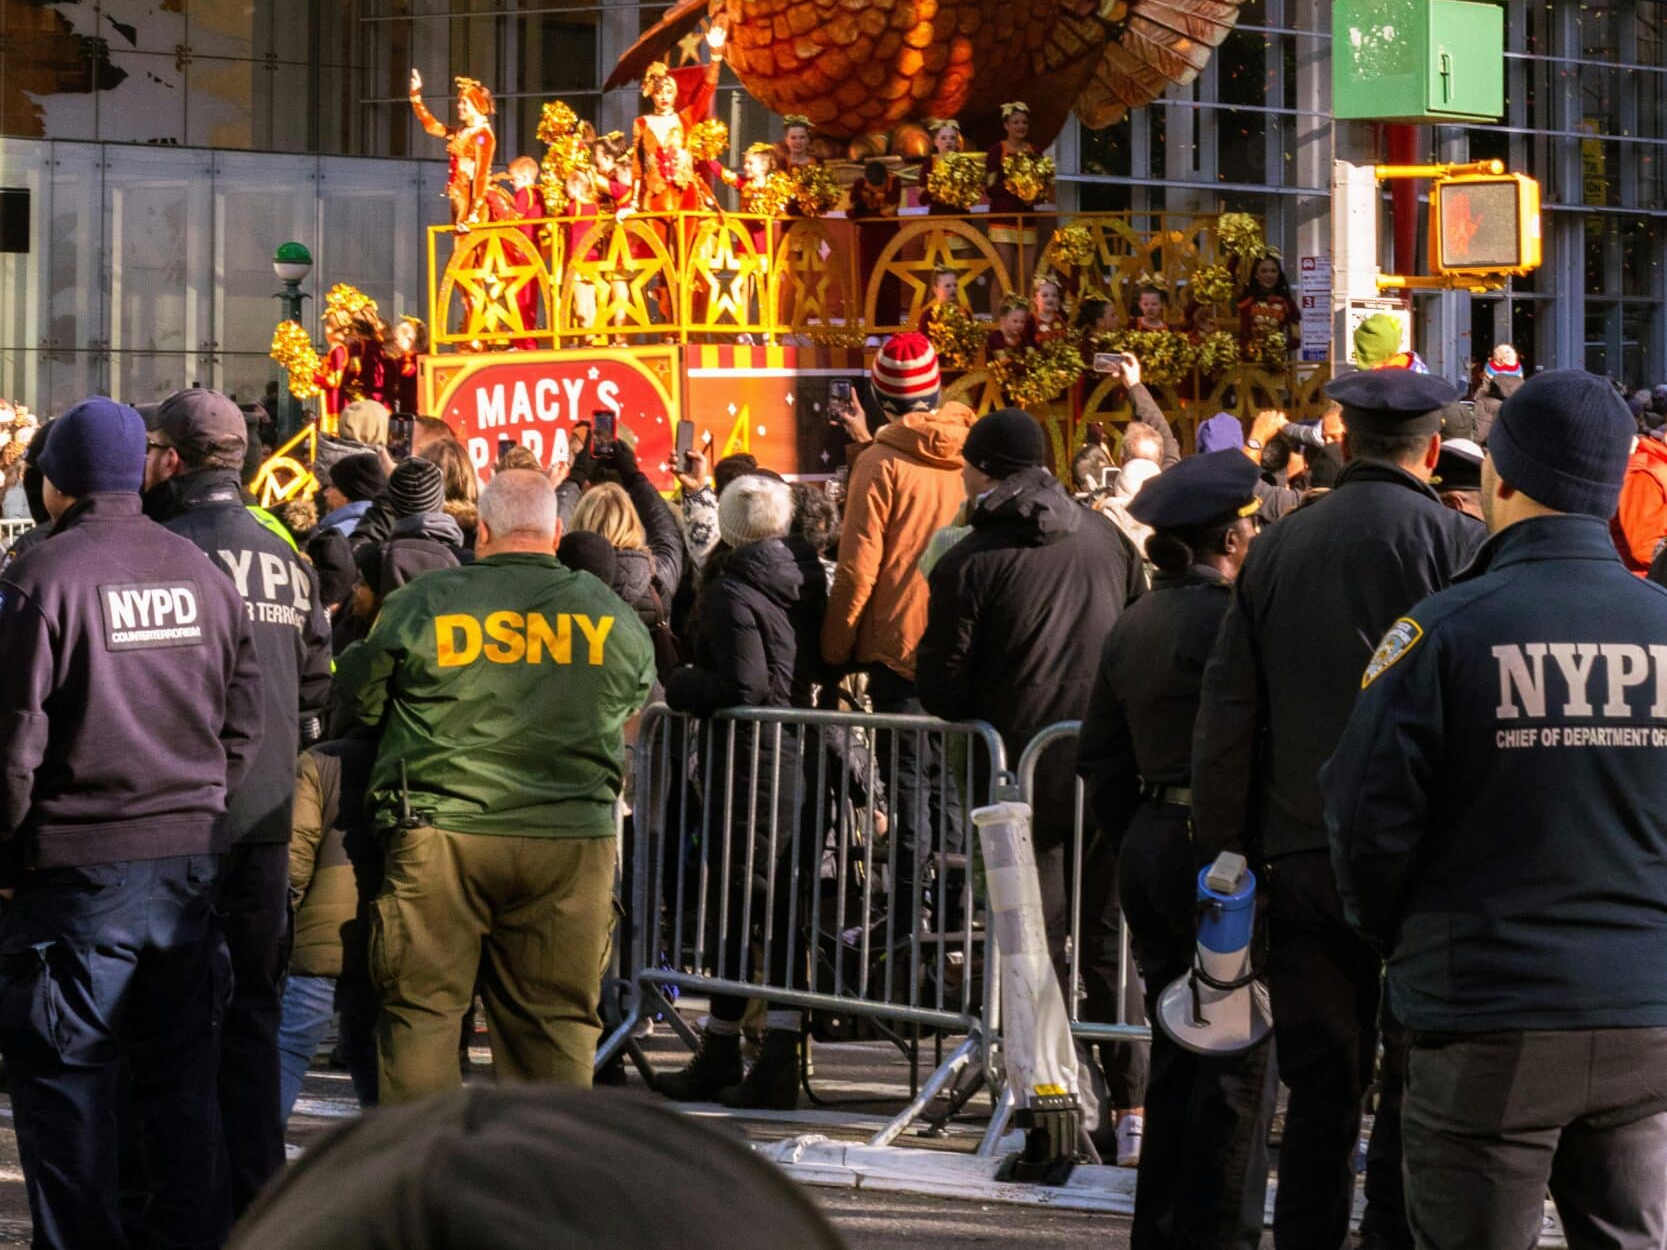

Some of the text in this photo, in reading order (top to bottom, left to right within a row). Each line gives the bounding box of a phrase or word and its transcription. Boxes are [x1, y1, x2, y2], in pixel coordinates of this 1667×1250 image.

[1303, 297, 1313, 307] 3
[476, 367, 621, 430] MACY'S
[204, 550, 312, 612] YPD
[108, 588, 197, 629] NYPD
[112, 626, 201, 643] COUNTERTERRORISM
[434, 611, 615, 667] DSNY
[1496, 728, 1667, 748] CHIEF OF DEPARTMENT OF
